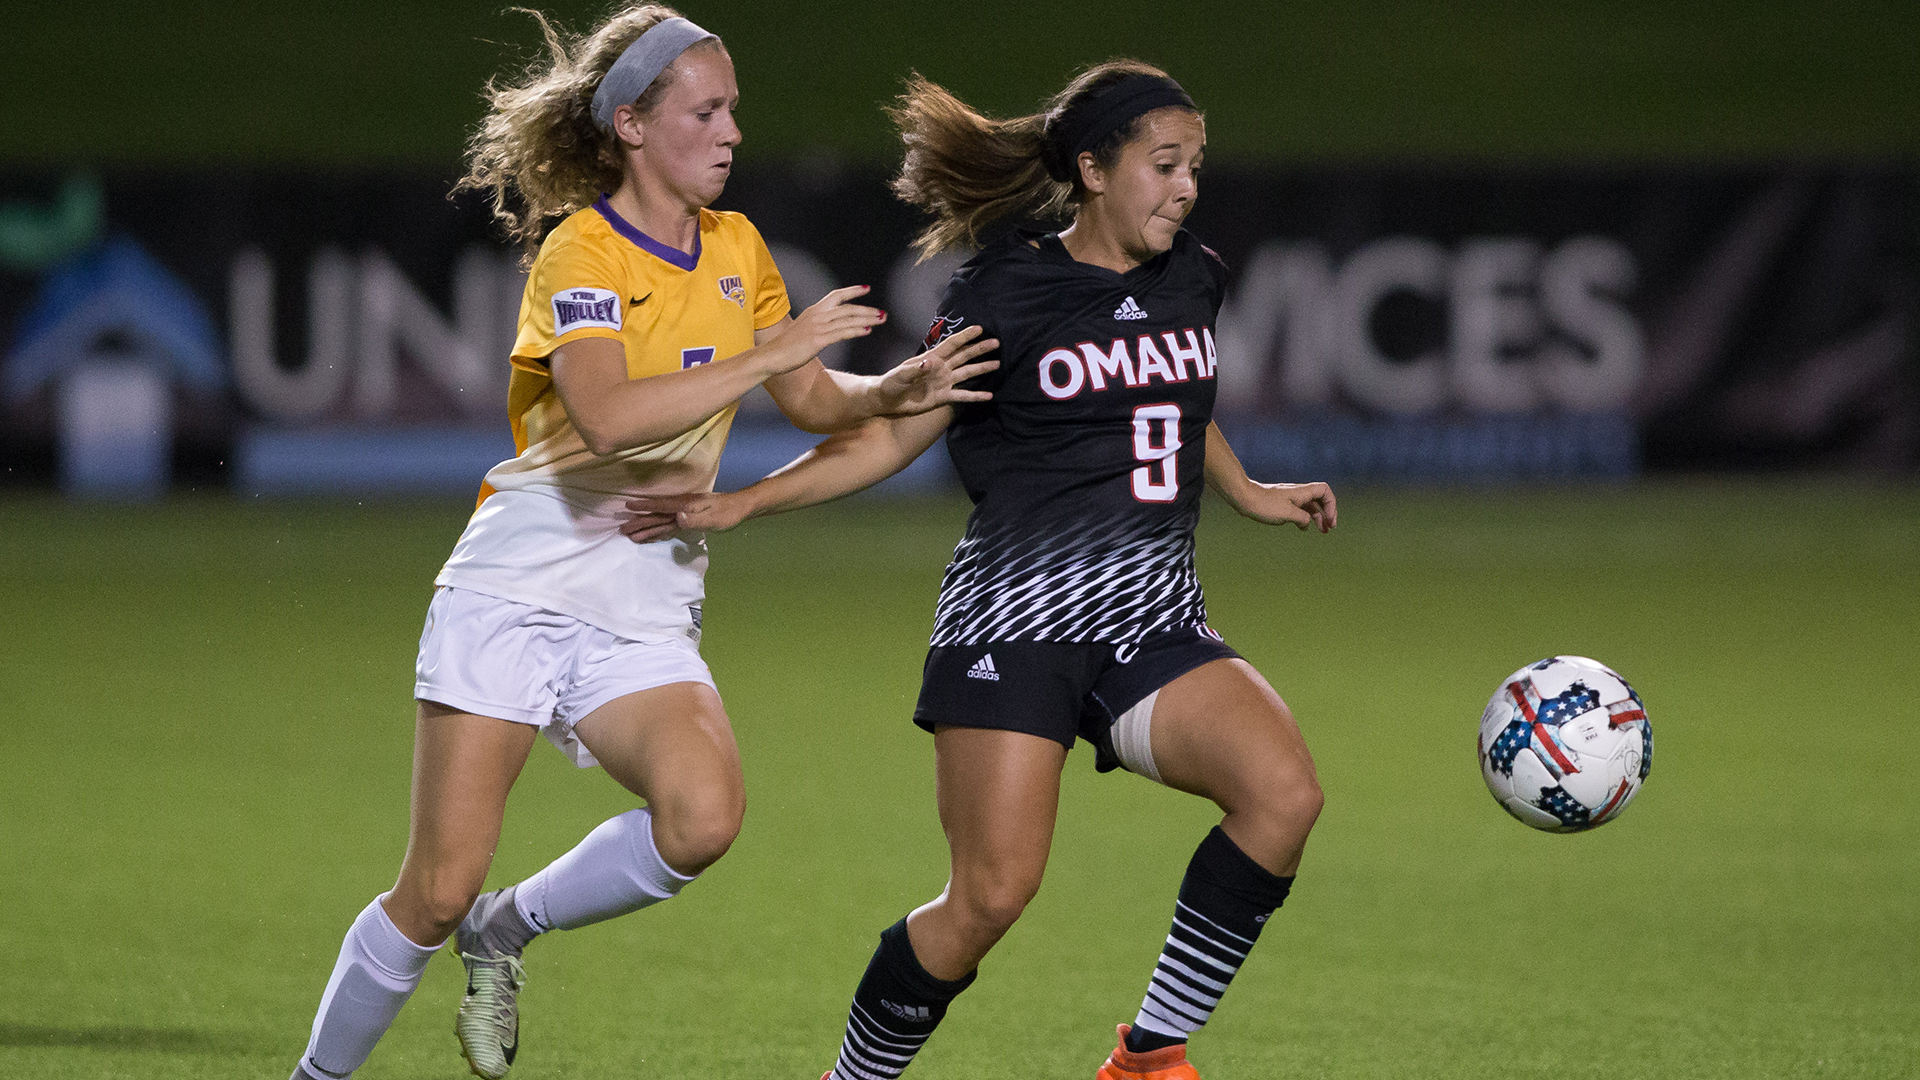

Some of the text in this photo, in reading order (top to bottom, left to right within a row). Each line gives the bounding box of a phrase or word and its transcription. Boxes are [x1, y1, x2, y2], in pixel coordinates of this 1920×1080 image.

[570, 291, 598, 302] THE
[554, 297, 619, 329] VALLEY
[1113, 310, 1148, 320] adidas
[1038, 325, 1217, 401] OMAHA
[1130, 402, 1183, 504] 9
[967, 669, 1000, 682] adidas
